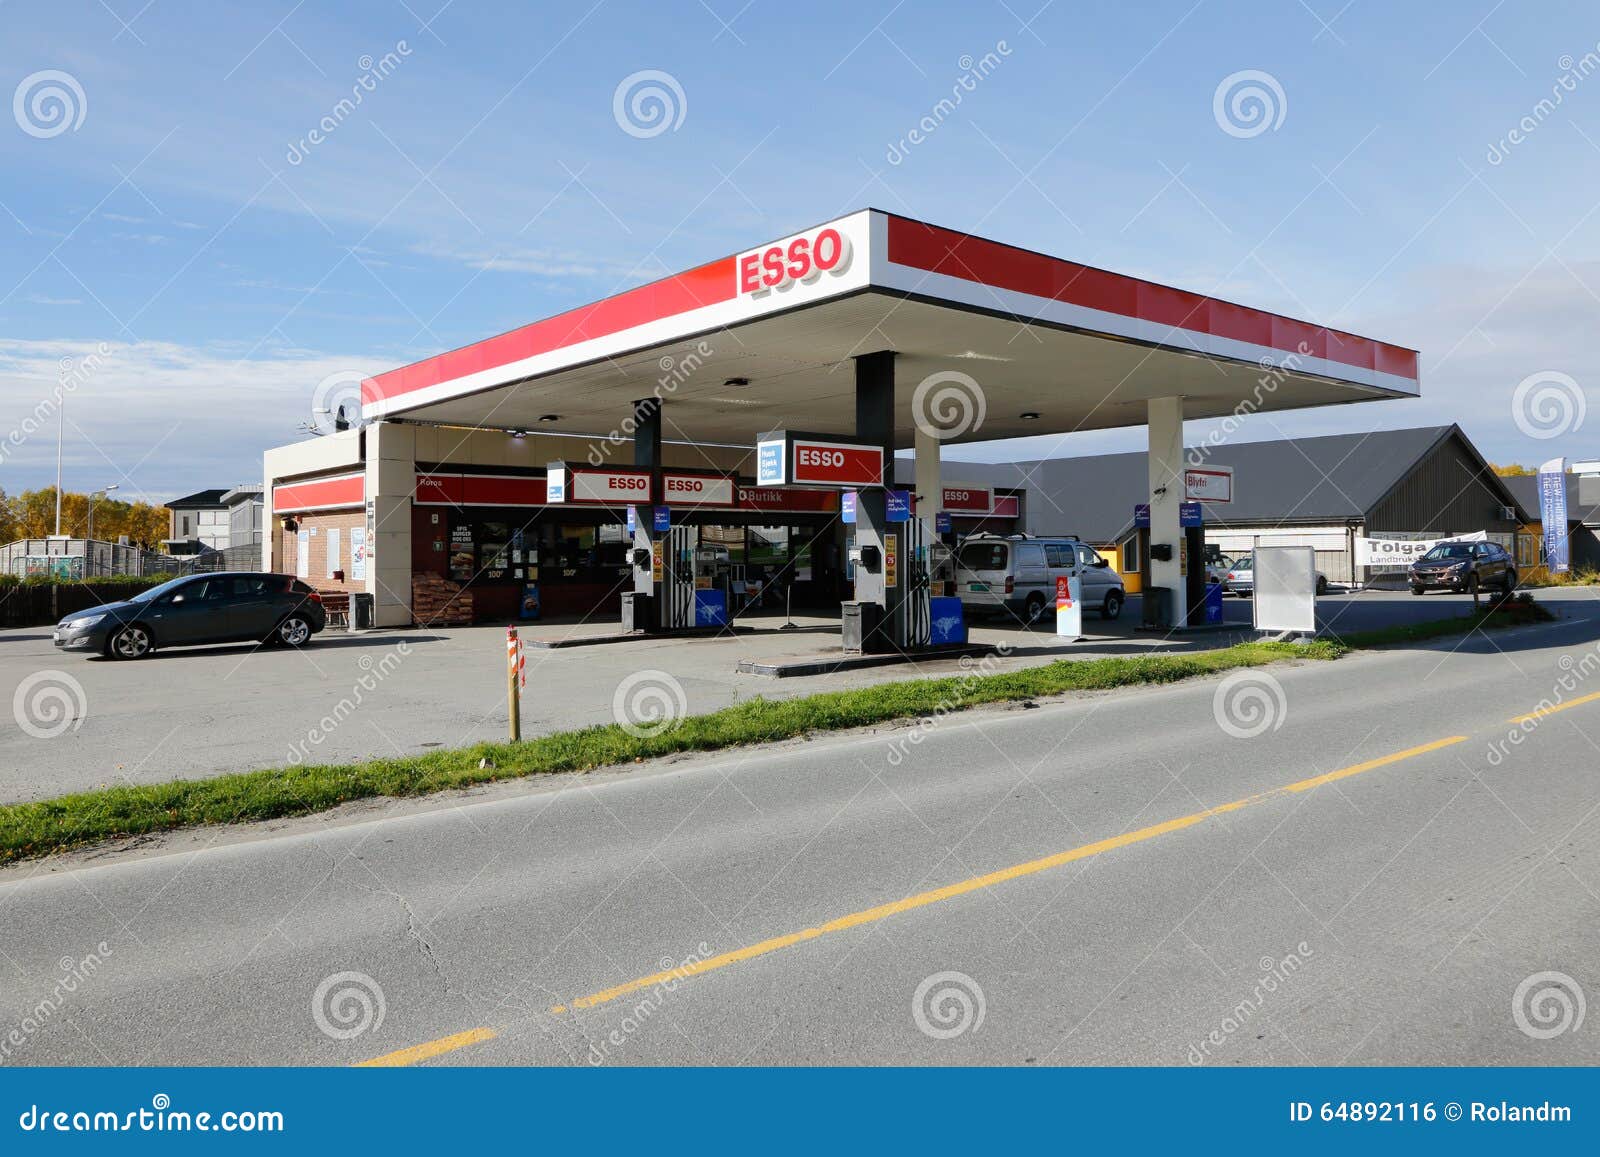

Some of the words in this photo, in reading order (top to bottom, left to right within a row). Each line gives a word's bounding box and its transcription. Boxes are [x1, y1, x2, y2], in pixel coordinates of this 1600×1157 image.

[741, 229, 846, 295] ESSO
[800, 450, 845, 467] ESSO
[608, 478, 647, 490] ESSO
[667, 480, 703, 492] ESSO
[1188, 475, 1207, 488] Blyfri
[748, 490, 782, 502] Butikk
[944, 491, 969, 501] ESSO
[1368, 541, 1426, 554] Tolga
